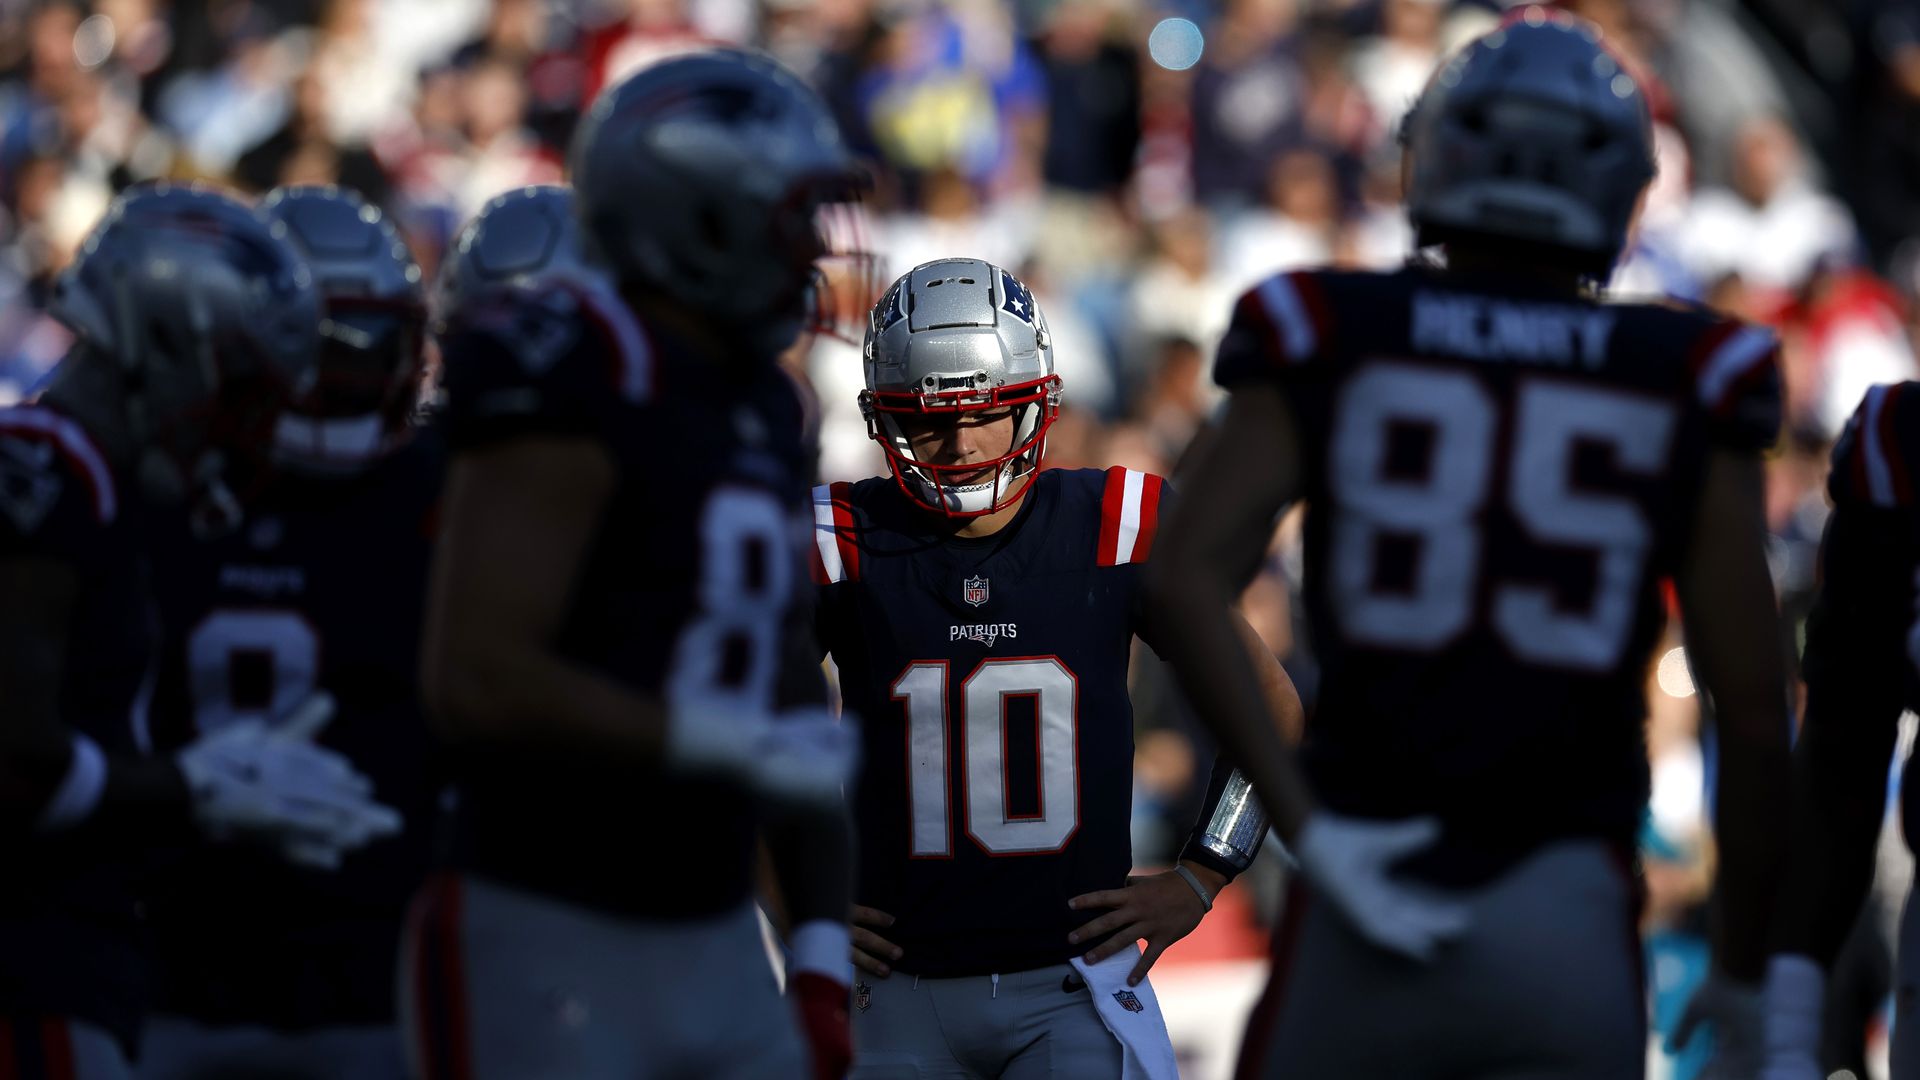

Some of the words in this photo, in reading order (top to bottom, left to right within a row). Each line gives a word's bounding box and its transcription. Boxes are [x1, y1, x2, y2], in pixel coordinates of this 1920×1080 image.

[1328, 358, 1678, 672] 85
[950, 623, 1017, 642] PATRIOTS
[968, 589, 986, 602] NFL
[890, 654, 1082, 859] 10
